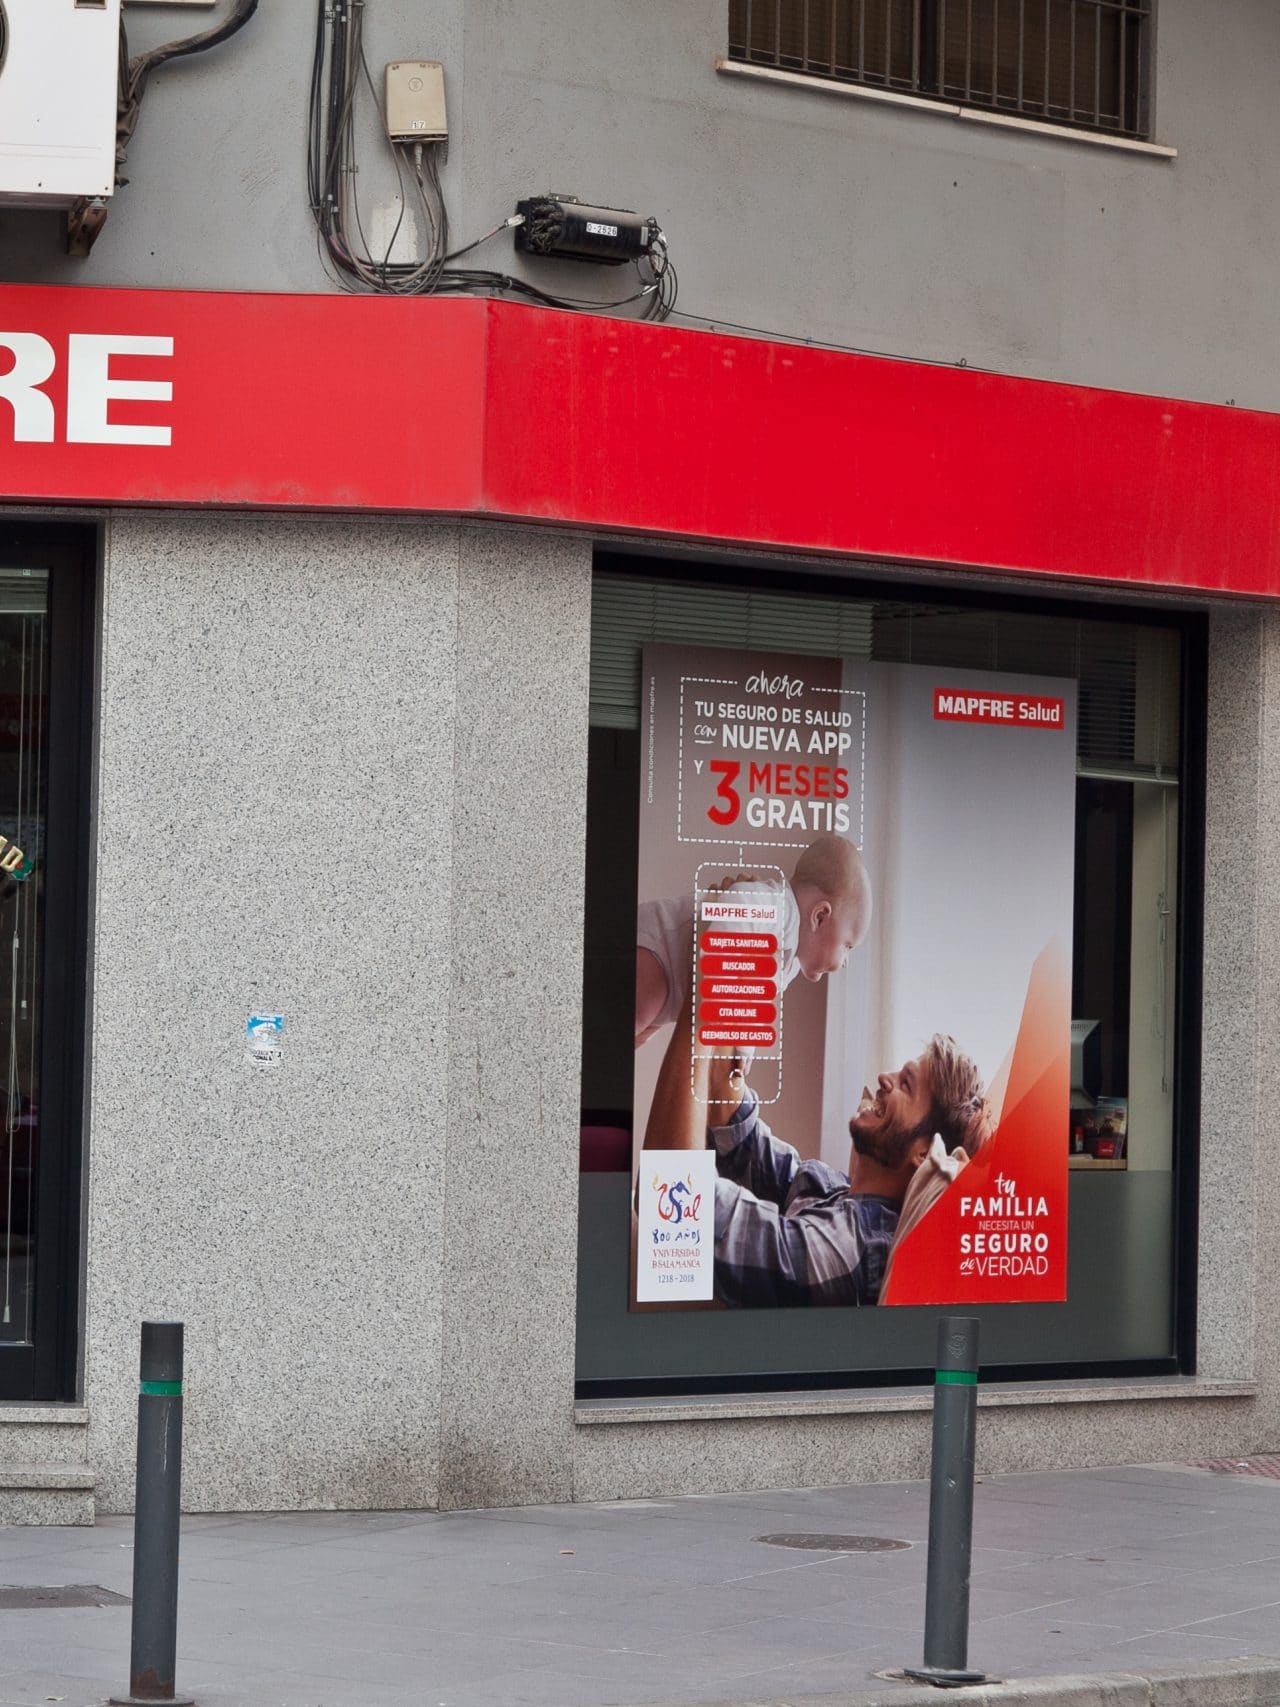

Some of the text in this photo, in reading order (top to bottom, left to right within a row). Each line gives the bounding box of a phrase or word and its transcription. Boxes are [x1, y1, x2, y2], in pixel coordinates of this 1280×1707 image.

[745, 670, 804, 700] ahora
[694, 701, 852, 728] TU SEGURO DE SALUD
[938, 695, 1060, 722] MAPFRE Salud
[722, 724, 802, 753] NUEVA
[807, 730, 852, 756] APP
[693, 759, 850, 826] Y 3 MESES
[746, 797, 850, 833] GRATIS
[704, 906, 775, 919] MAPFRE Salud
[709, 938, 770, 949] TARJETA SANITARIA
[722, 961, 756, 972] BUSCADOR
[712, 984, 766, 995] AUTORIZACIONES
[719, 1007, 757, 1018] CITA ONLINE
[701, 1030, 773, 1041] REEMBOLSO DE GASTOS
[994, 1172, 1016, 1198] tu
[960, 1196, 1049, 1217] FAMILIA
[978, 1220, 1035, 1231] NECESITA UN
[960, 1232, 1049, 1254] SEGURO
[976, 1256, 1049, 1277] VERDAD
